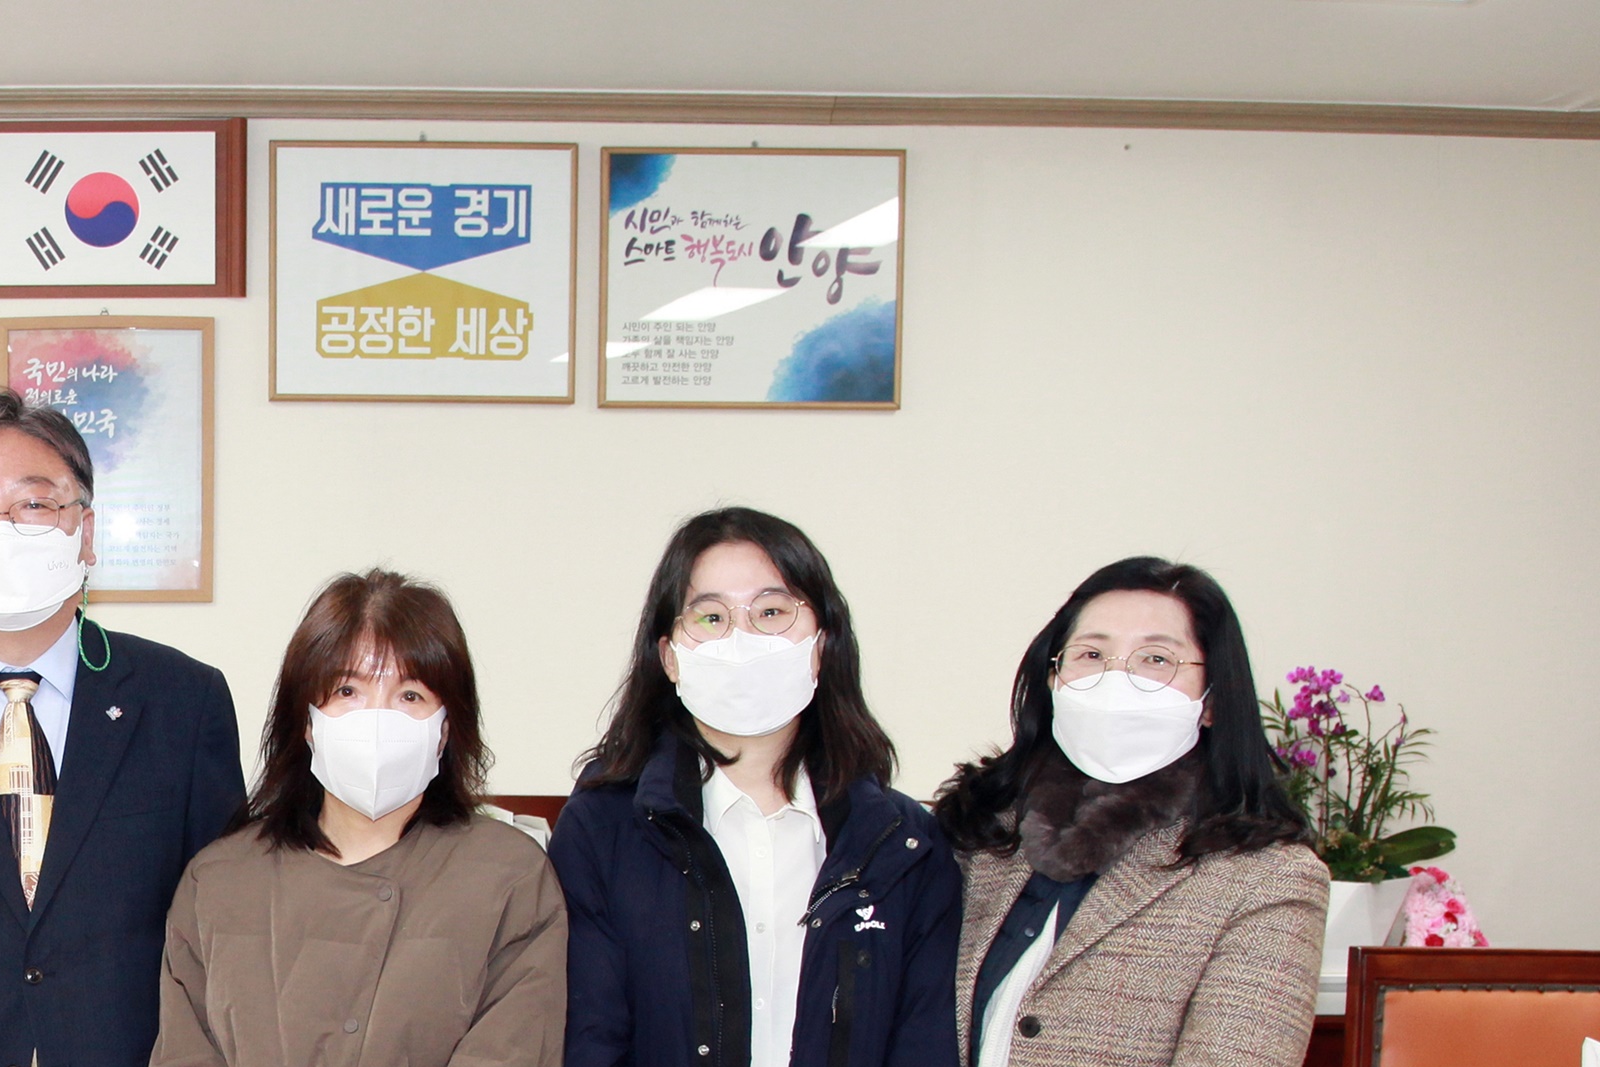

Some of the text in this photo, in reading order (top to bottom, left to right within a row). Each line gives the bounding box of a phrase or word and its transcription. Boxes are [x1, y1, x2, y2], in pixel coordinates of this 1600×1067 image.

[319, 186, 528, 239] 새로운 경기
[624, 207, 749, 235] 시민과 함께하는
[624, 233, 753, 287] 스마트 행복도시
[758, 212, 883, 305] 안양
[320, 305, 528, 357] 공정한 세상
[622, 322, 716, 332] 시민이 주인 되는 안양
[653, 335, 672, 346] 삶을
[675, 335, 712, 346] 책임지는
[715, 335, 735, 346] 안양
[621, 362, 712, 372] 깨끗하고 안전한 안양
[644, 348, 663, 359] 함께
[666, 348, 675, 359] 잘
[678, 349, 697, 359] 사는
[700, 348, 720, 359] 안양
[22, 357, 118, 386] 국민의 나라
[621, 375, 712, 386] 고르게 발전하는 안양
